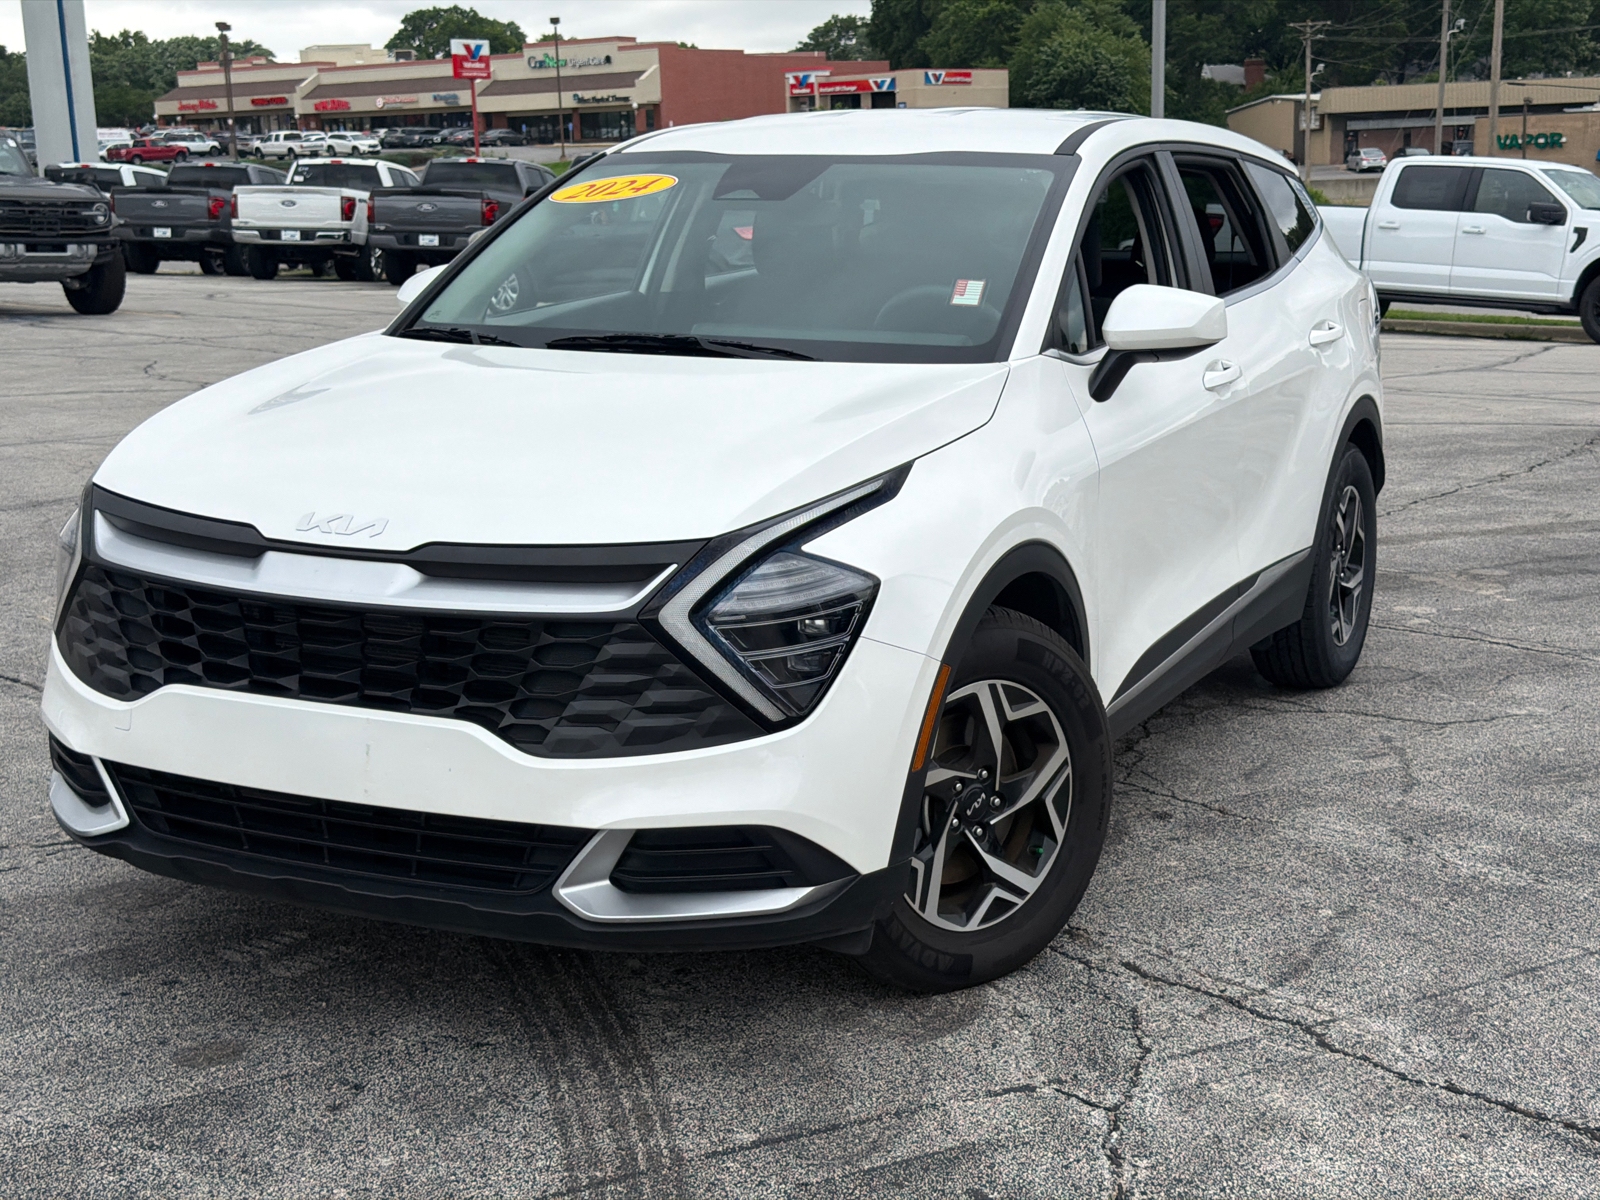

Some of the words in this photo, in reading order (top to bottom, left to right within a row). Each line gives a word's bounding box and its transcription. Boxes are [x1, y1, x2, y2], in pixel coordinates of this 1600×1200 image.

[1497, 132, 1563, 150] VAPOR
[562, 178, 664, 200] 2024
[296, 511, 389, 538] KIA
[886, 917, 955, 971] ADVAN
